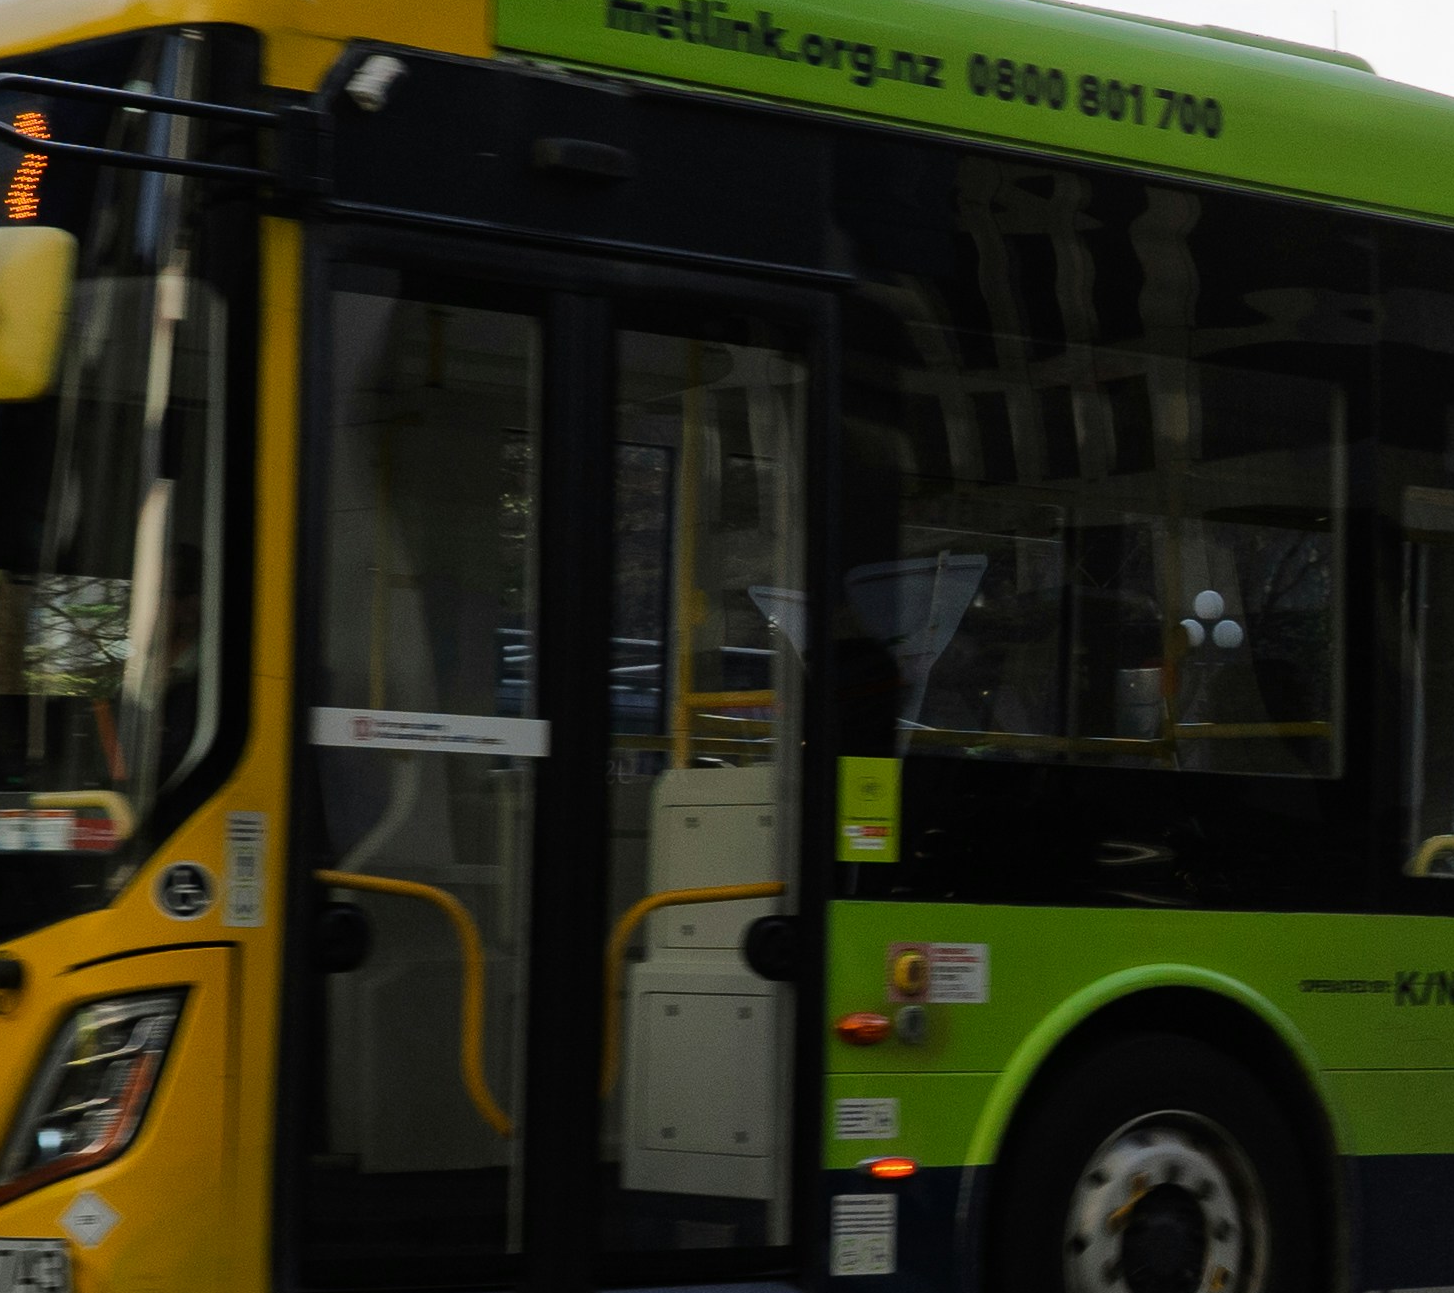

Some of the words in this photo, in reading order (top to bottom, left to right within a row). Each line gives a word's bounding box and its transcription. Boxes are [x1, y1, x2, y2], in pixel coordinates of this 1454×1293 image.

[966, 52, 1067, 109] 0800
[1077, 74, 1146, 127] 801
[1153, 87, 1222, 139] 700
